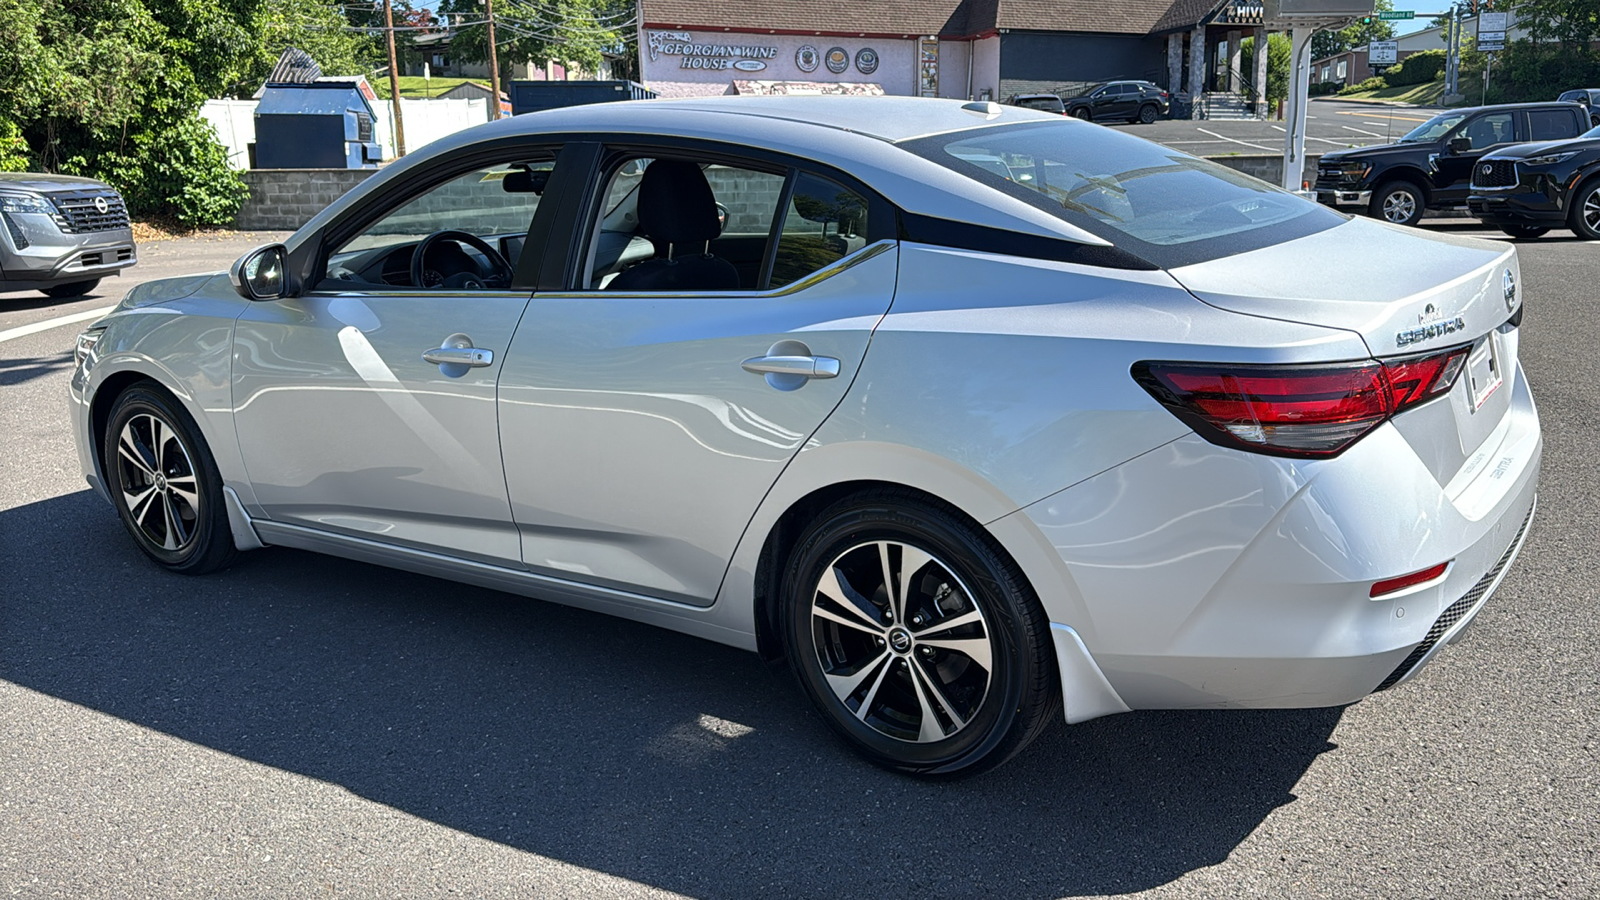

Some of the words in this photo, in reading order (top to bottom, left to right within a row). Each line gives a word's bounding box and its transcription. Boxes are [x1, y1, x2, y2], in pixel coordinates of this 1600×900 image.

[664, 43, 736, 57] GEORGIAN
[741, 46, 778, 59] WINE
[680, 57, 728, 70] HOUSE
[1396, 317, 1465, 348] SENTRA
